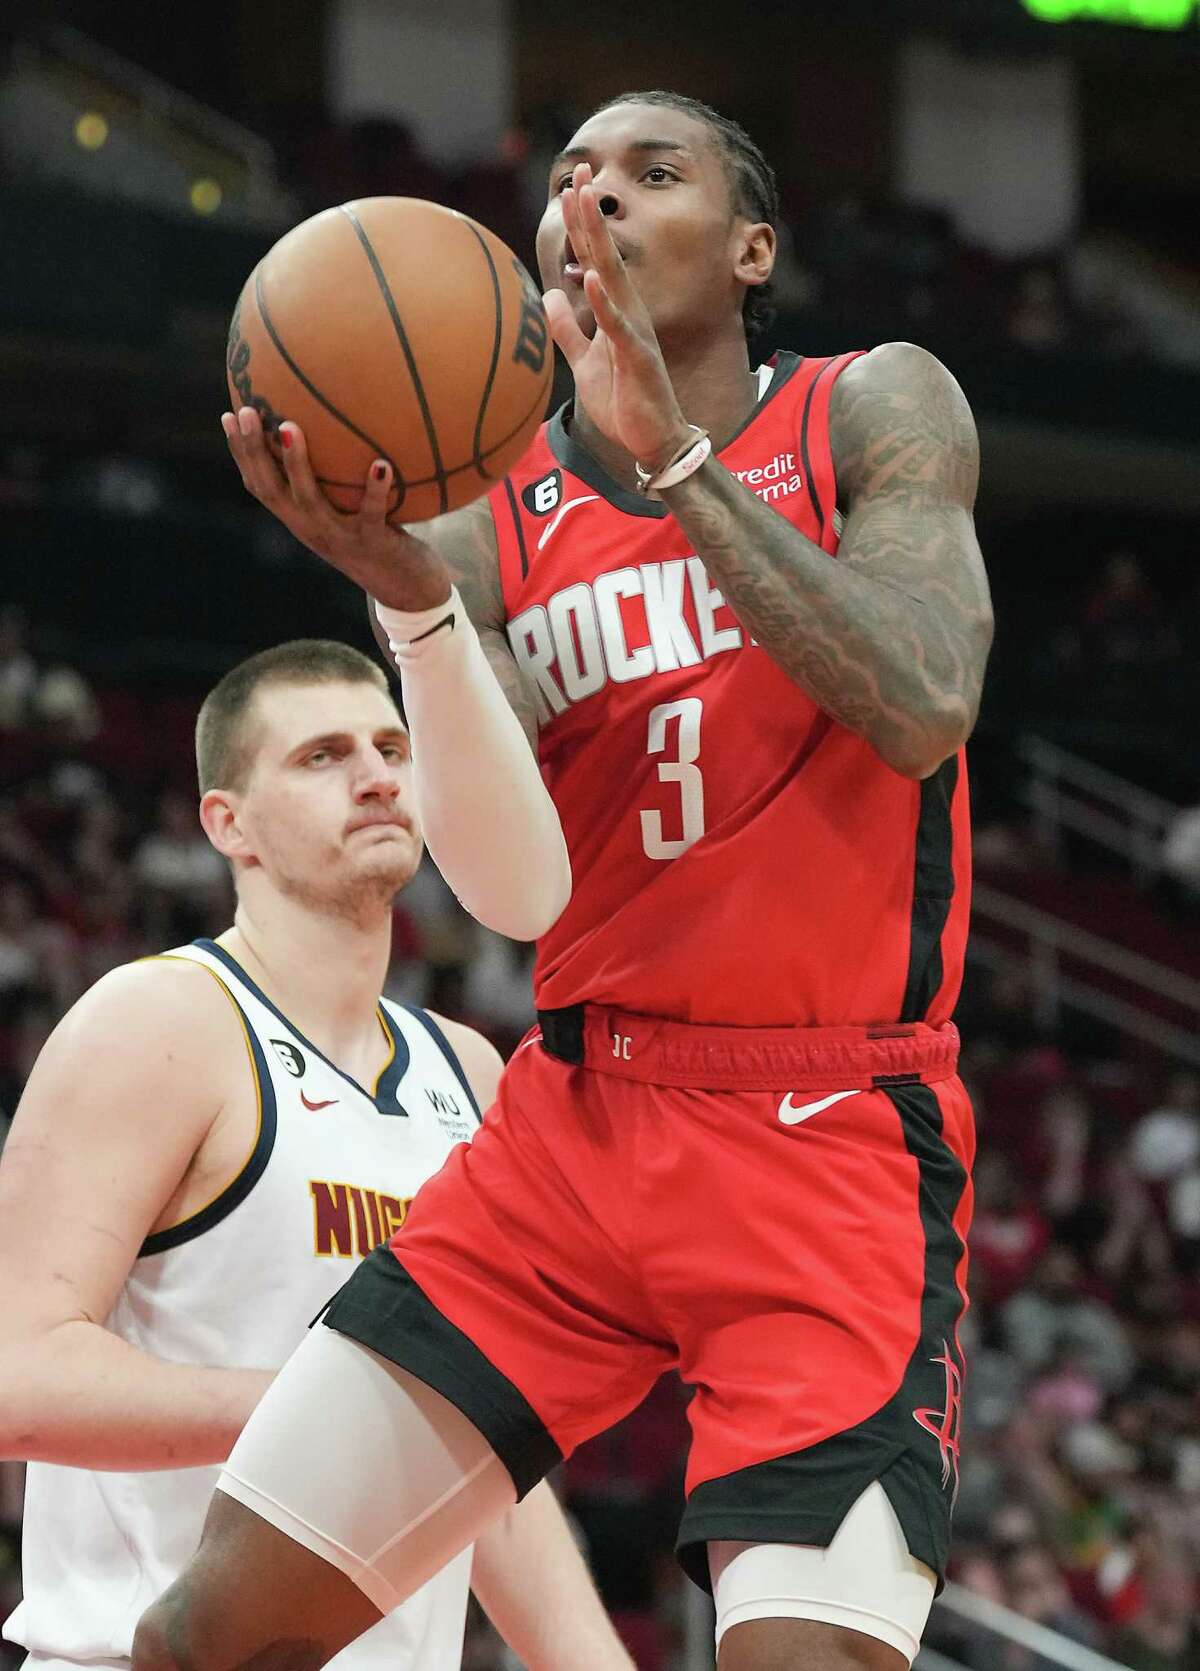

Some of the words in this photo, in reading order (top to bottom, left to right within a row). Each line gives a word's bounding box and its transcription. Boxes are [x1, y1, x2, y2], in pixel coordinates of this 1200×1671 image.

[534, 475, 559, 512] 6
[506, 556, 761, 730] ROCKE
[639, 697, 705, 860] 3
[423, 1087, 461, 1116] WU
[308, 1179, 416, 1259] NUG
